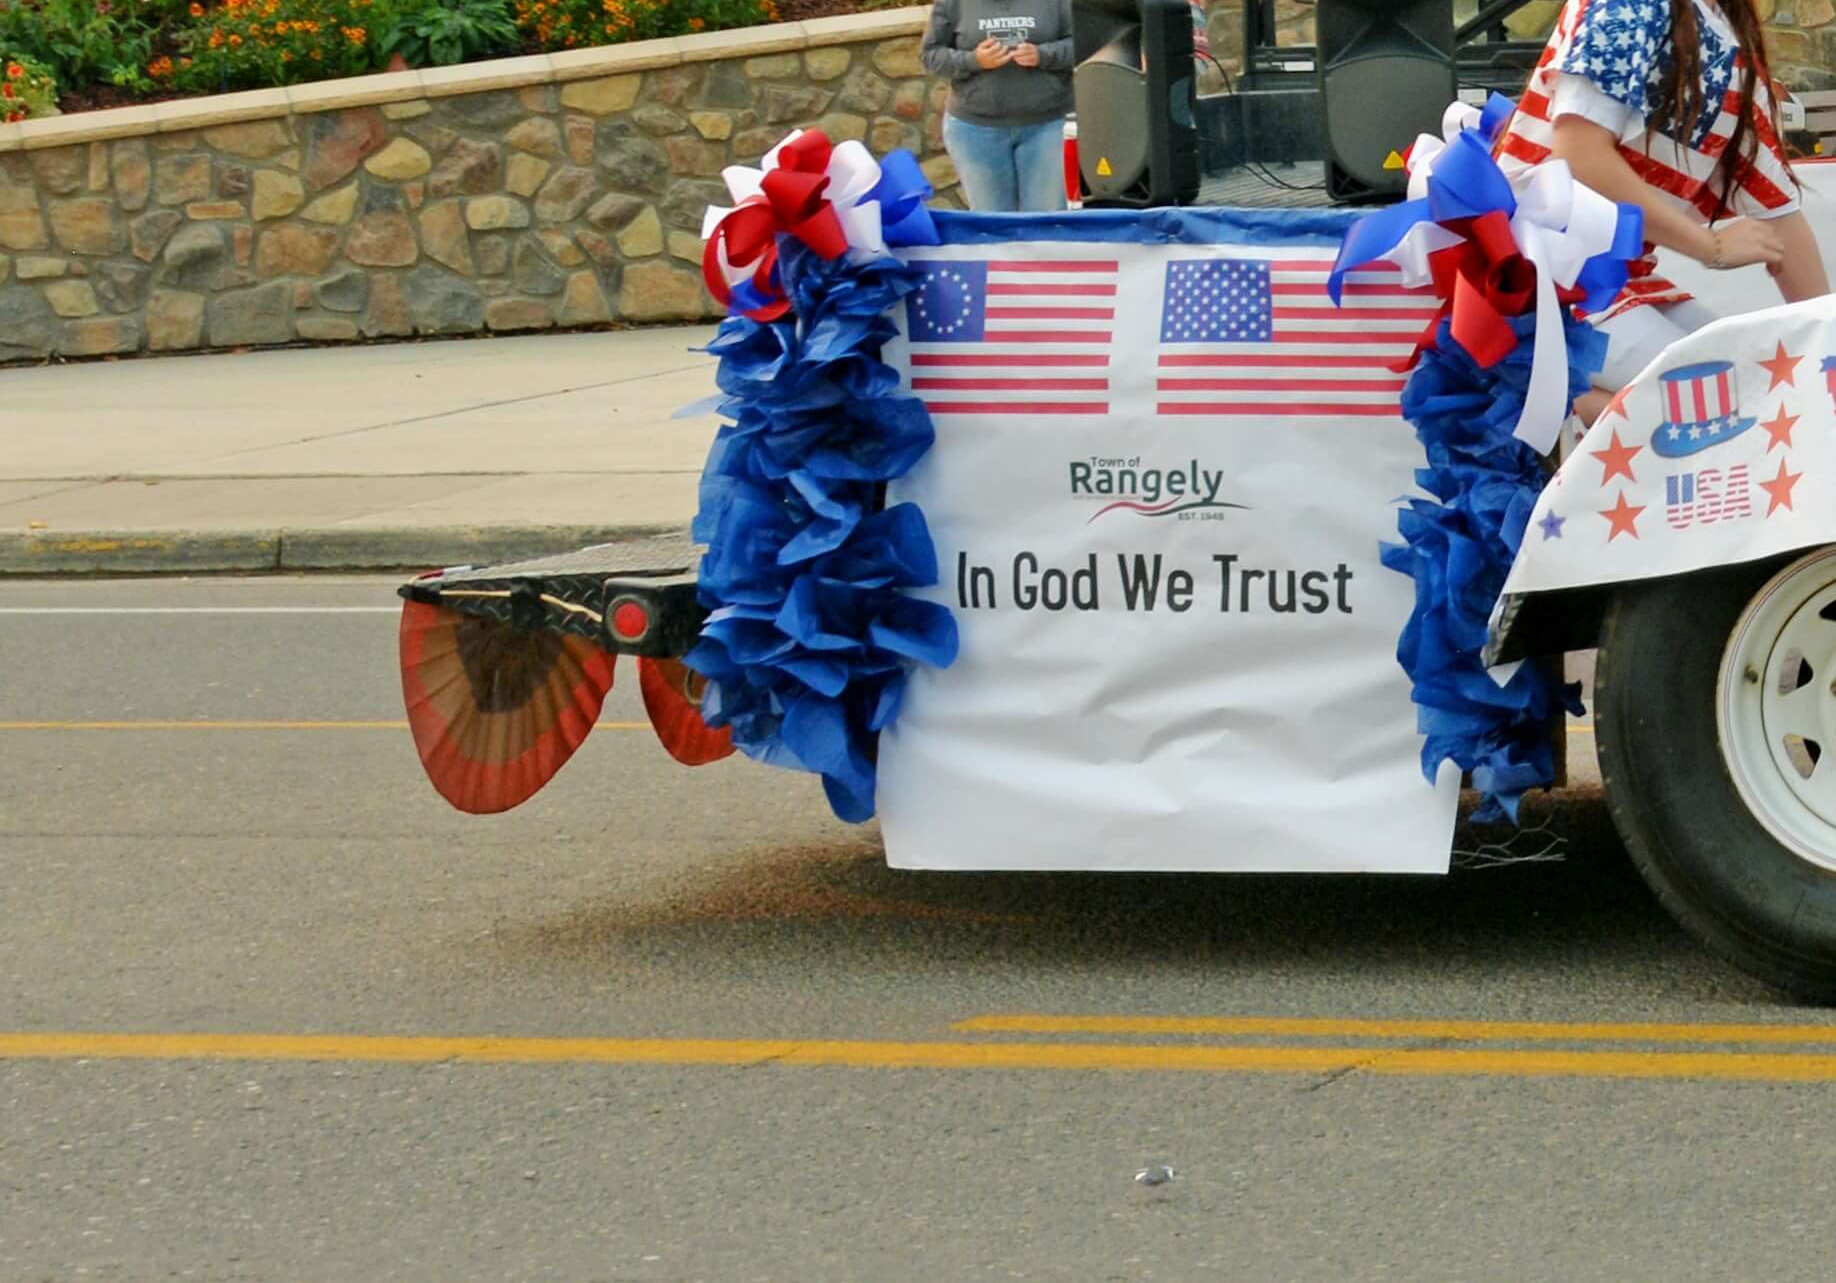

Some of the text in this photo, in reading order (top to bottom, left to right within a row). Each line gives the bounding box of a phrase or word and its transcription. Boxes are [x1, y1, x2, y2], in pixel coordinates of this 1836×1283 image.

[978, 17, 1036, 31] PANTHERS
[1070, 459, 1223, 502] Rangely
[1090, 456, 1140, 467] Town of
[1666, 464, 1752, 529] USA
[957, 551, 1353, 614] In God We Trust
